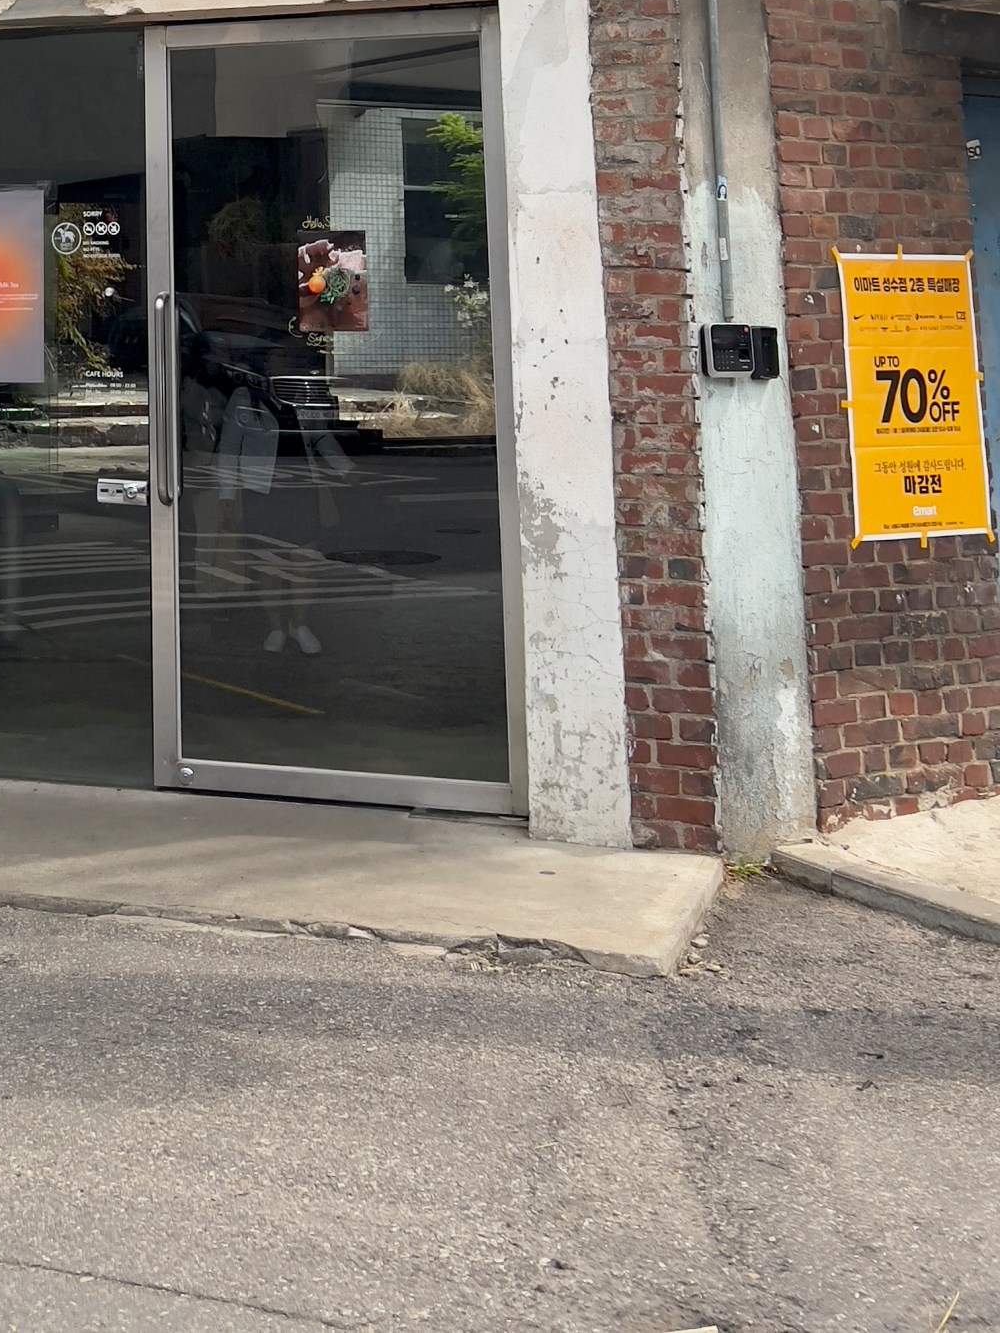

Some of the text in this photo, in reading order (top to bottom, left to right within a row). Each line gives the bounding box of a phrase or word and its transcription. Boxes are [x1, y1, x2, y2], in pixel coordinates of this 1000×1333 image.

[82, 210, 103, 218] SORRY
[853, 277, 960, 293] 이마트 성수점 2층 특설매장
[874, 356, 900, 368] UP TO
[85, 370, 124, 378] CAFE HOURS
[875, 368, 960, 424] 70% OFF
[874, 461, 897, 474] 그동안
[900, 459, 921, 473] 성원에
[903, 474, 943, 495] 마감전
